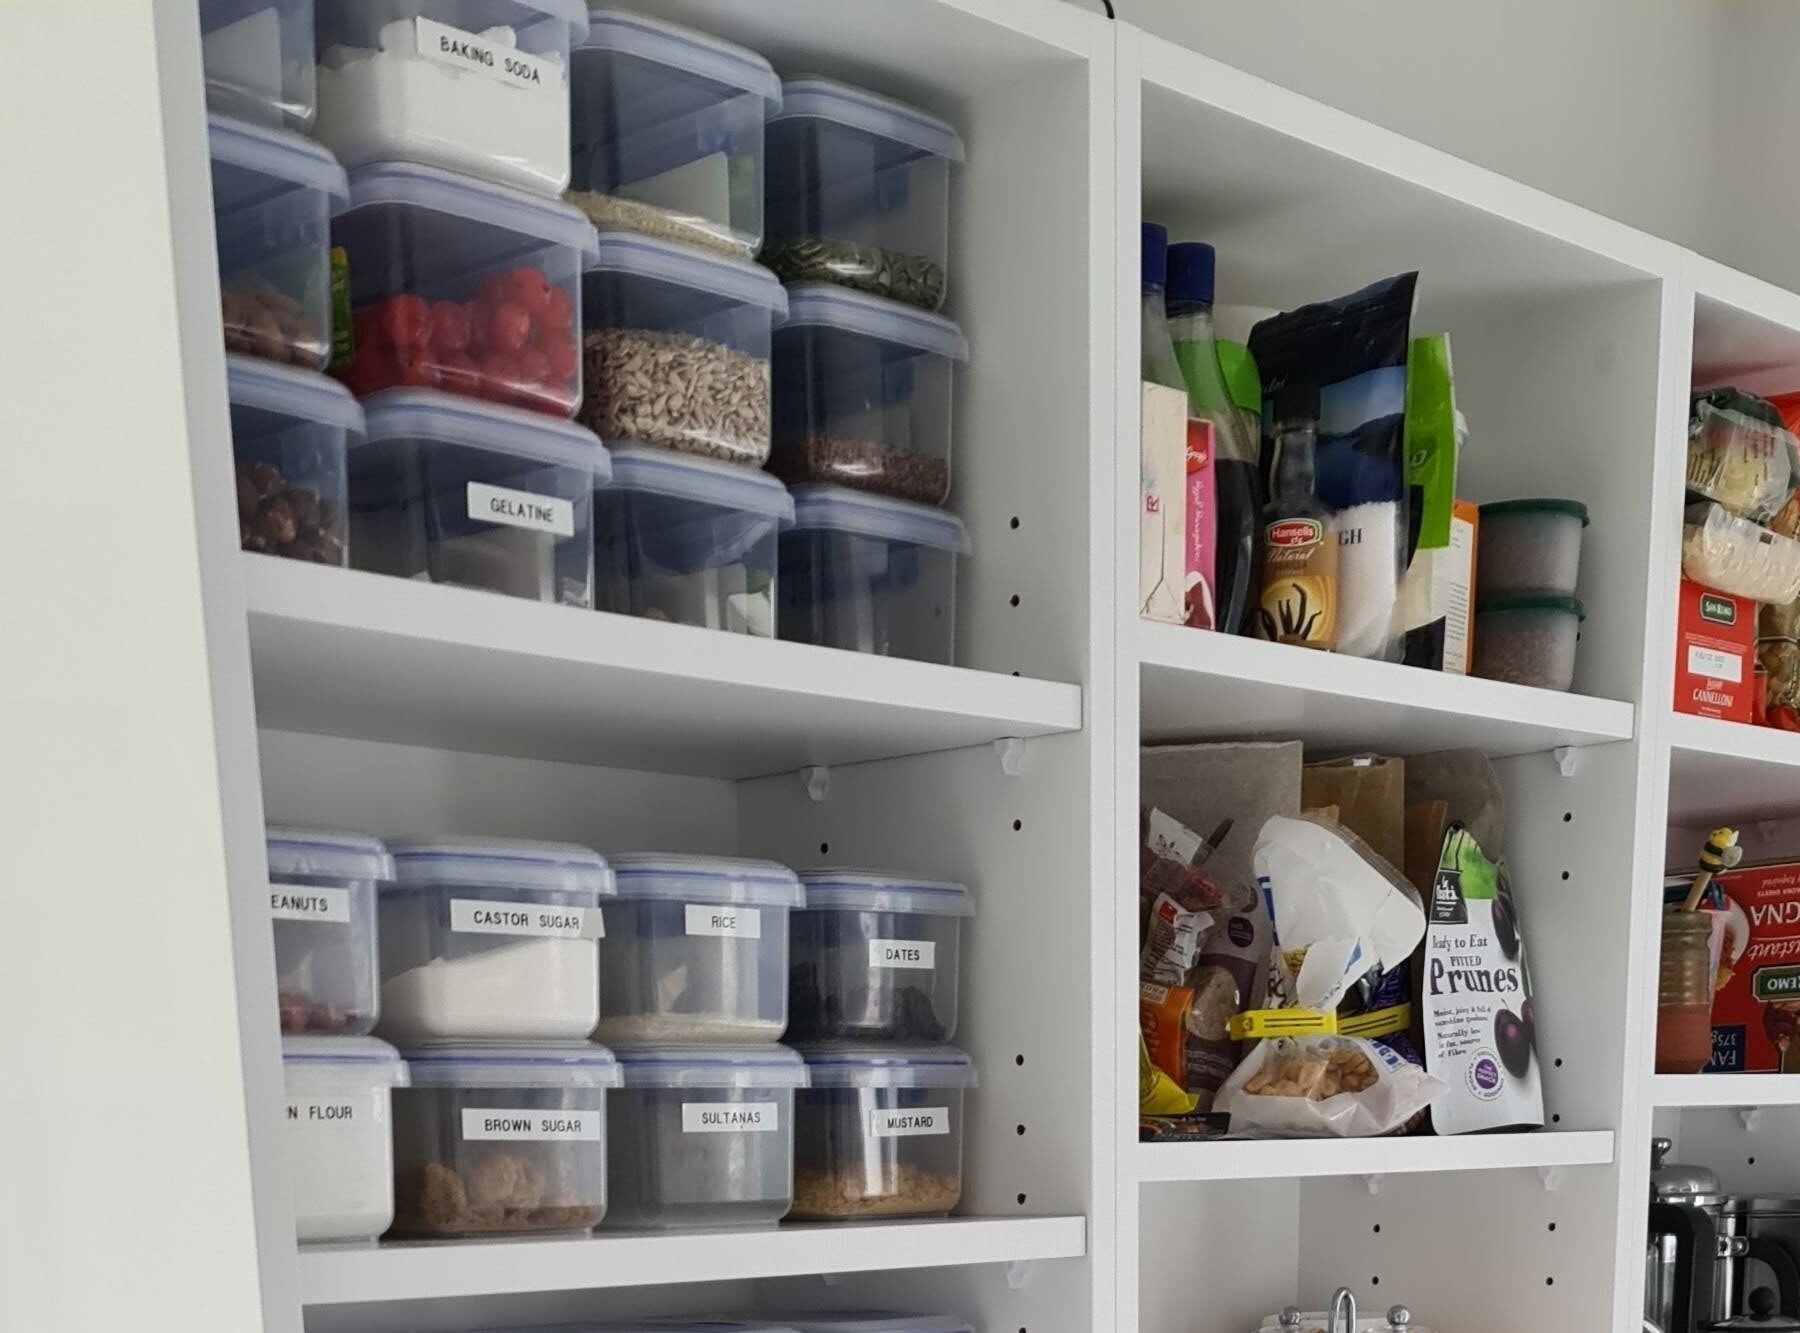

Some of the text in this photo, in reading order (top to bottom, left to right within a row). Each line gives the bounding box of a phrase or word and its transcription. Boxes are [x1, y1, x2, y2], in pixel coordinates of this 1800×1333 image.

[439, 35, 542, 86] BAKING SODA
[490, 496, 555, 525] GELATINE
[271, 894, 329, 912] EANUTS
[473, 910, 580, 930] CASTOR SUGAR
[711, 916, 737, 930] RICE
[1455, 938, 1466, 948] to
[1470, 934, 1488, 948] Eat
[886, 948, 920, 961] DATES
[1450, 955, 1482, 967] PITTED
[1430, 957, 1519, 996] Prunes
[309, 1106, 353, 1120] FLOUR
[702, 1111, 761, 1125] SULTANAS
[484, 1118, 582, 1133] BROWN SUGAR
[887, 1115, 934, 1129] MUSTARD
